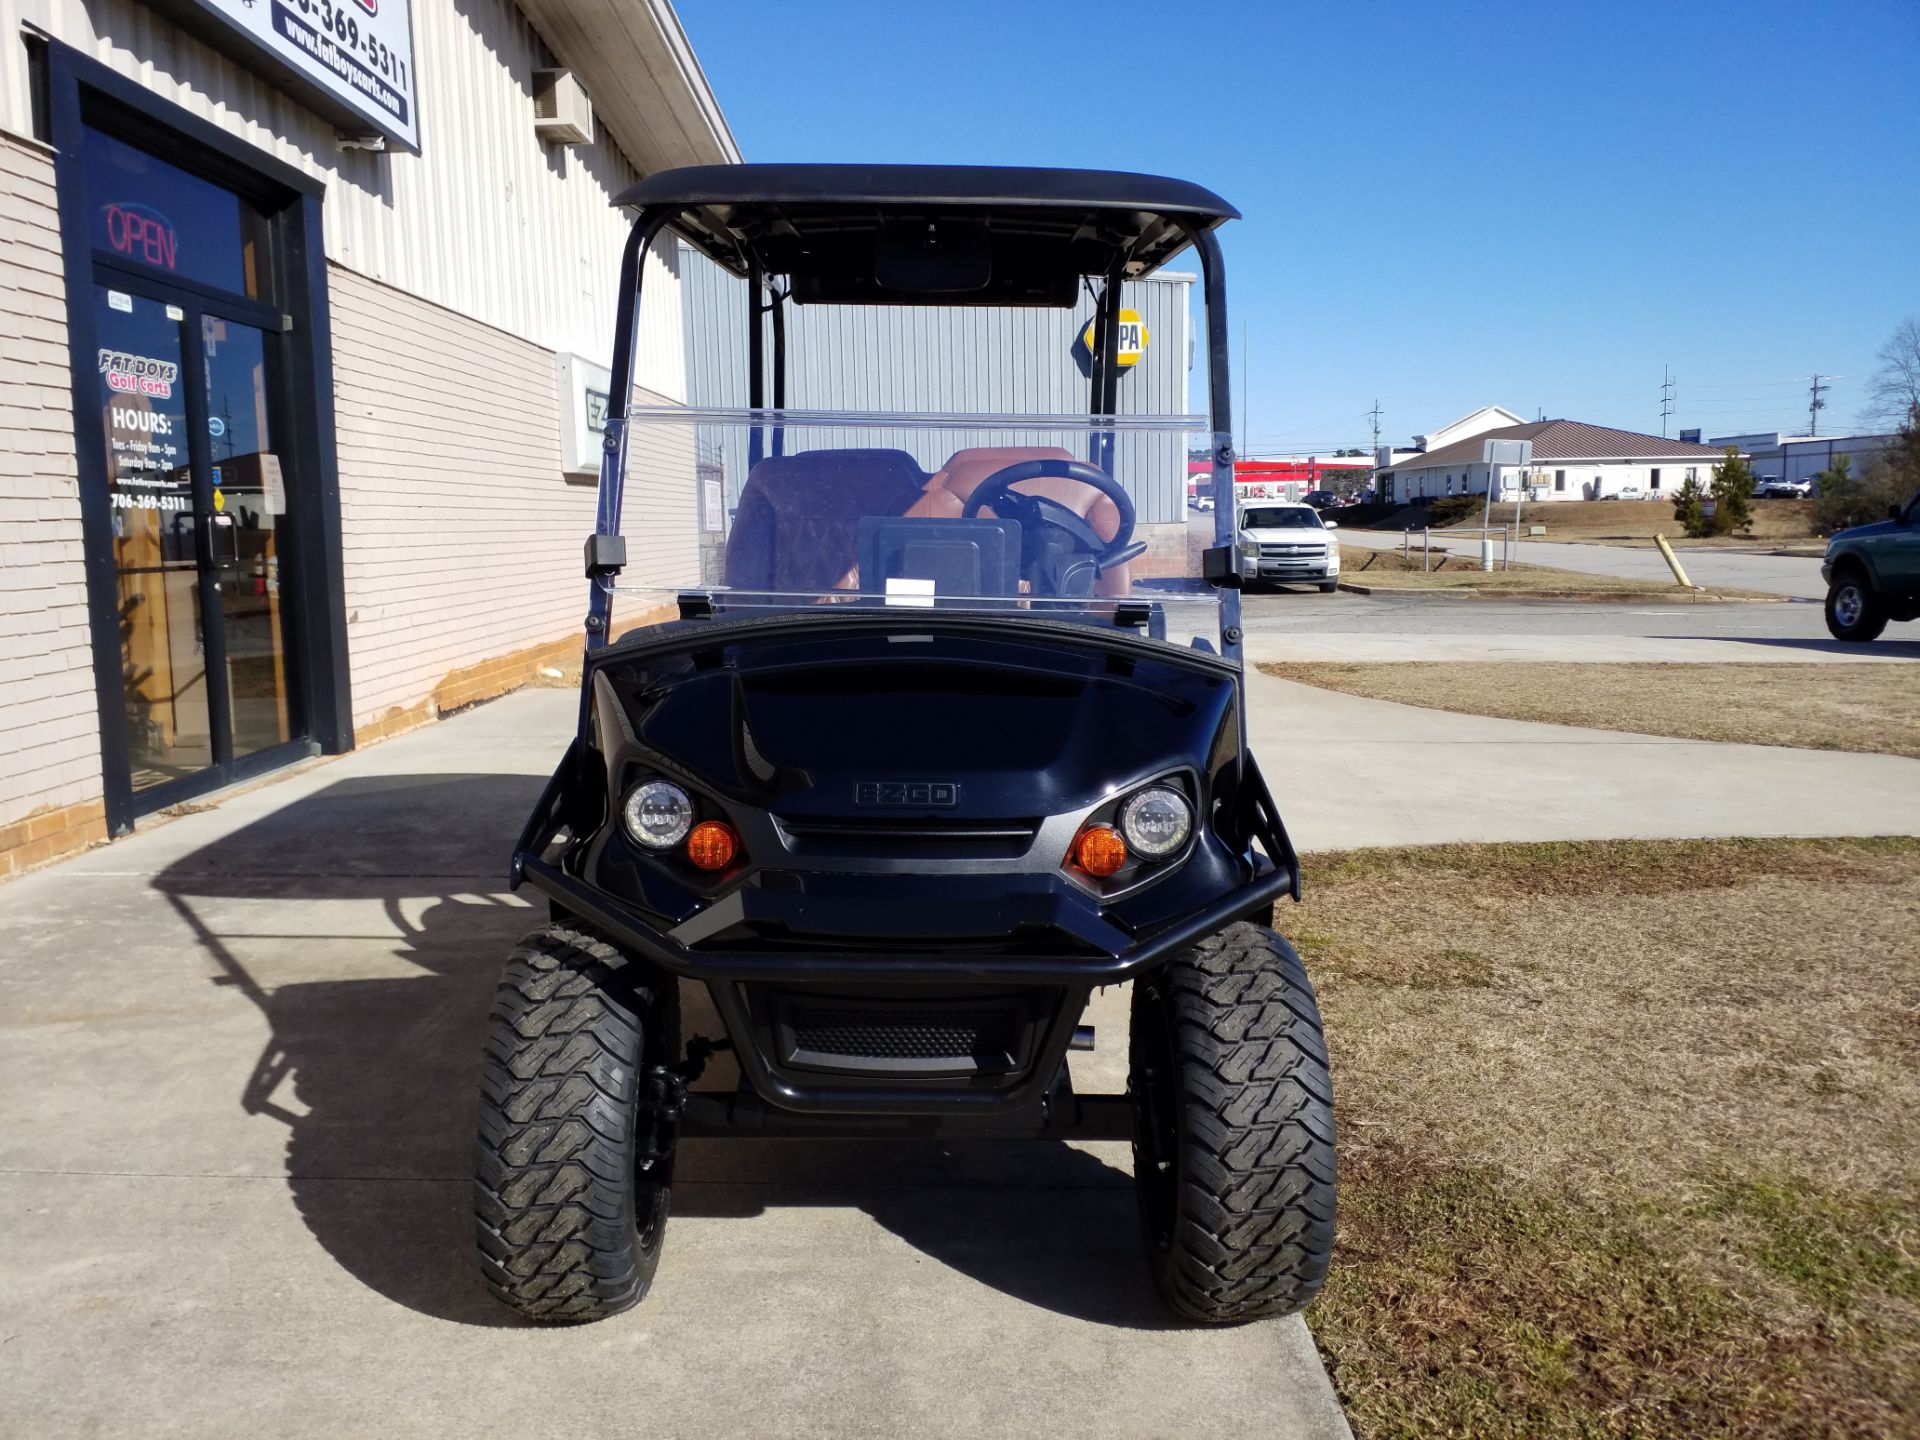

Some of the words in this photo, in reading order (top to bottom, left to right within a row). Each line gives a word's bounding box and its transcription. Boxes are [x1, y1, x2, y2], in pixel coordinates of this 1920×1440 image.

[288, 0, 407, 91] -369-5311
[284, 16, 400, 115] www.fatboyscarts.com
[107, 205, 175, 269] OPEN
[1119, 324, 1140, 350] PA
[100, 353, 132, 372] FAT
[135, 360, 175, 379] BOYS
[109, 372, 137, 389] Golf
[140, 377, 169, 394] Carts
[112, 407, 172, 435] HOURS:
[112, 438, 125, 450] Tues
[129, 440, 148, 455] Friday
[118, 455, 144, 471] Saturday
[110, 493, 185, 511] 706-369-5311
